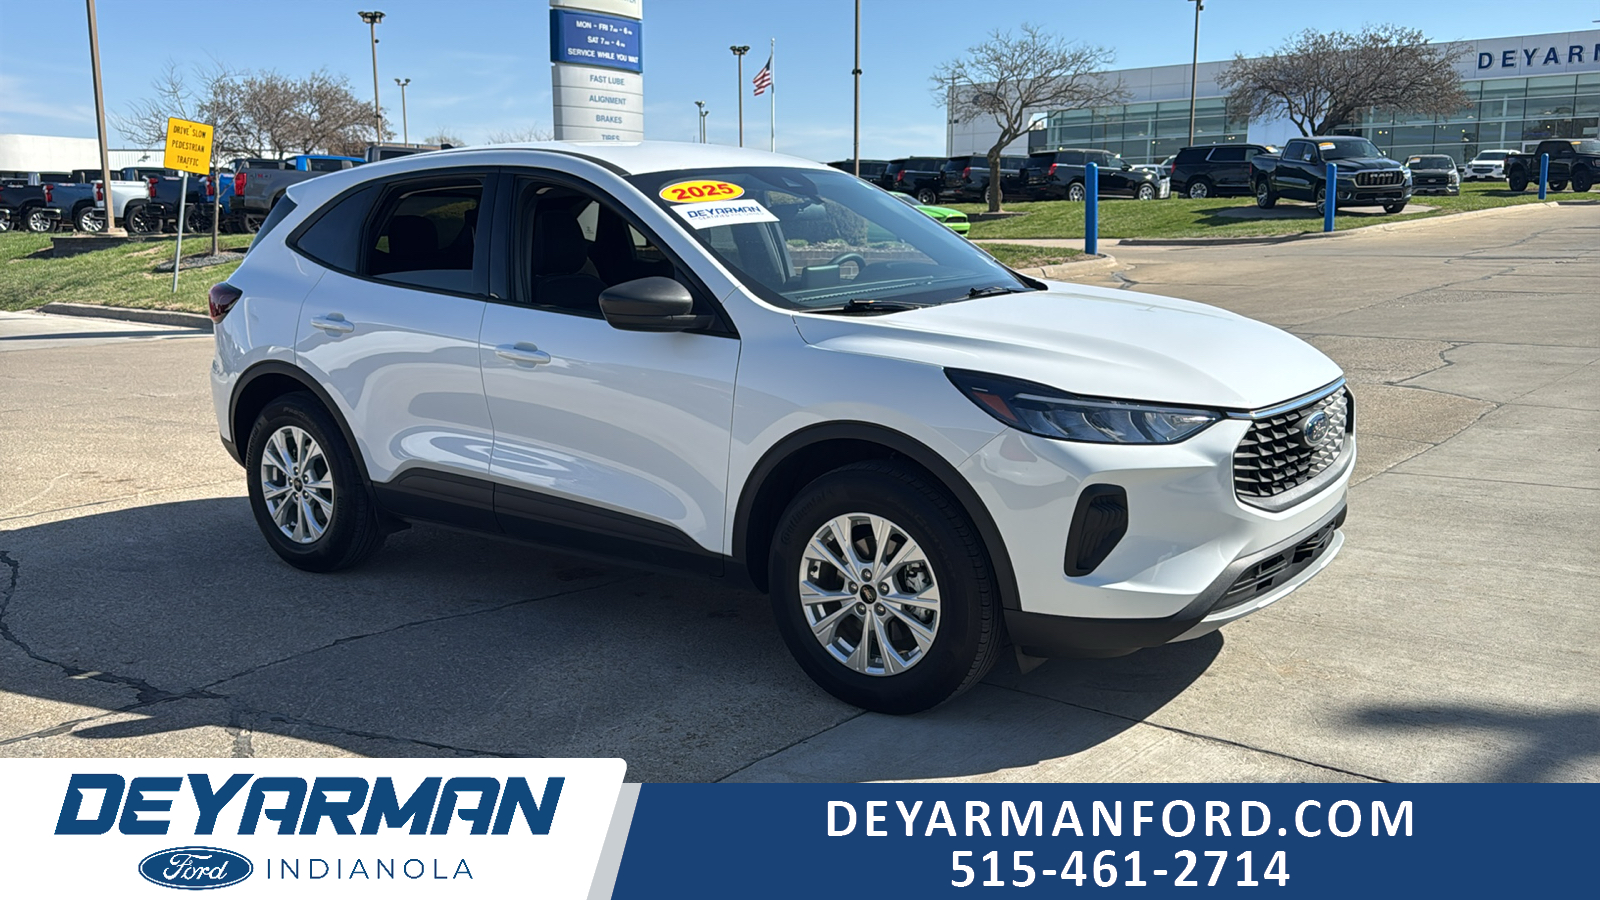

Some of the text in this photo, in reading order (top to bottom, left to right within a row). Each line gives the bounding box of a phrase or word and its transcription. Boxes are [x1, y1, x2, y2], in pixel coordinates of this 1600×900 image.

[576, 20, 592, 29] MON
[598, 23, 609, 31] FRI
[587, 36, 599, 44] SAT
[567, 48, 596, 58] SERVICE
[597, 51, 615, 60] WHILE
[616, 53, 628, 62] YOU
[589, 75, 625, 86] FAST LUBE
[589, 95, 627, 105] ALIGNMENT
[595, 114, 623, 124] BRAKES
[173, 125, 207, 139] DRIVE SLOW
[171, 139, 205, 153] PEDESTRIAN
[176, 155, 199, 167] TRAFFIC
[671, 183, 734, 200] 2025
[687, 206, 761, 218] DEYARMAN
